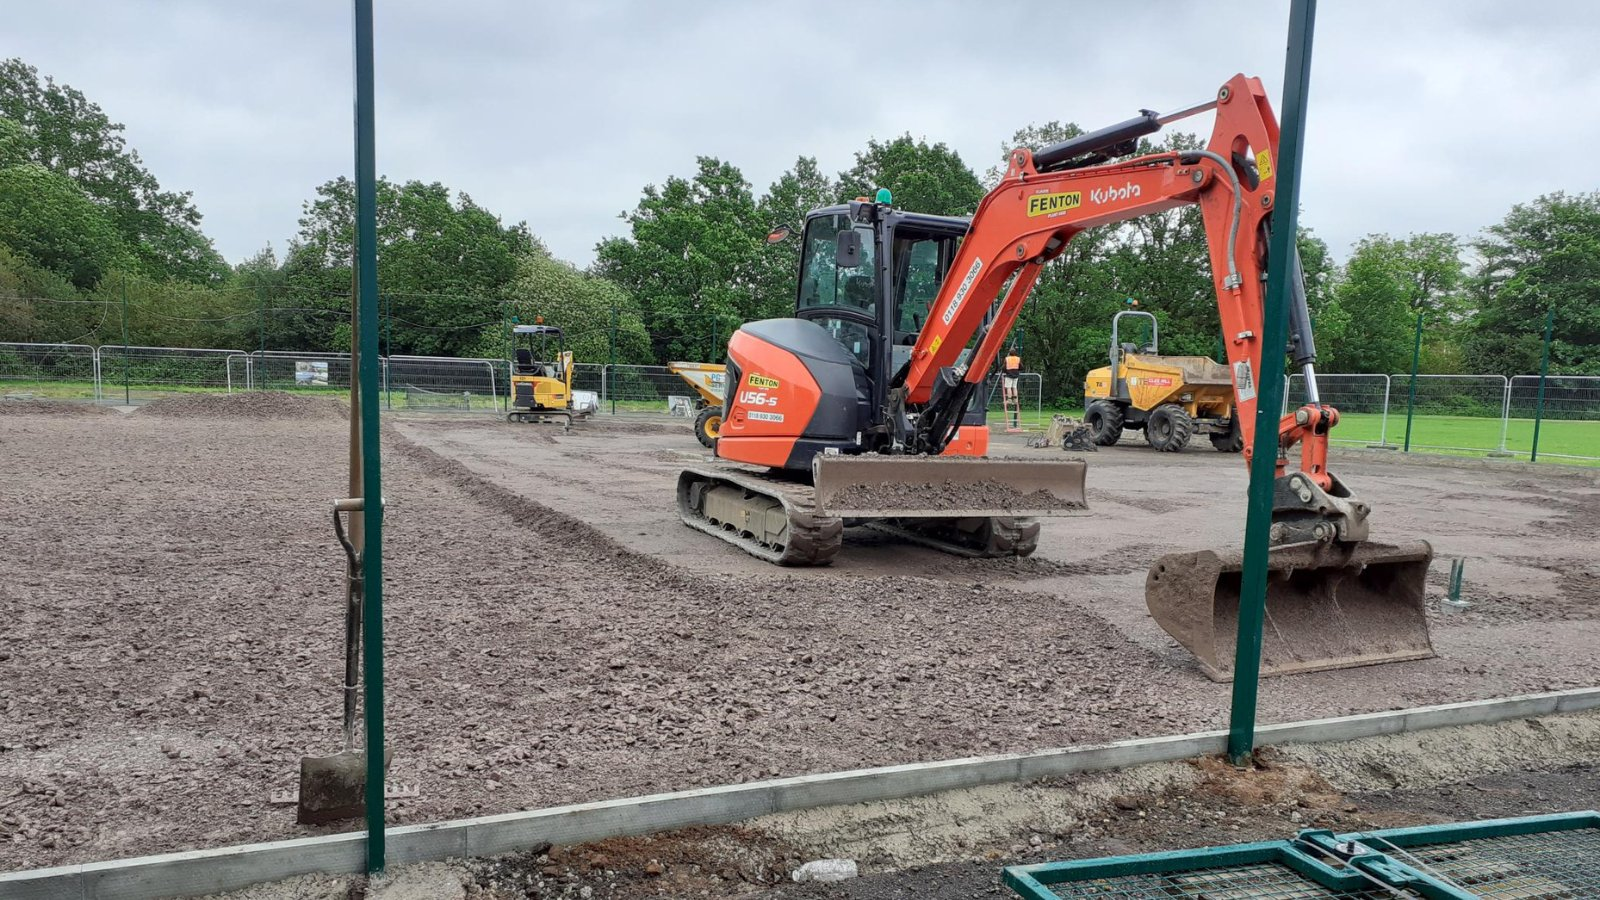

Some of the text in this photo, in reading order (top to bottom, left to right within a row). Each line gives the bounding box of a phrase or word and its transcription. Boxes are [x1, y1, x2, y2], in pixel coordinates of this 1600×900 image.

[1030, 194, 1081, 213] FENTON
[1090, 181, 1141, 205] Kubota
[944, 261, 981, 322] 0118 930 3066
[749, 375, 779, 388] FENTON
